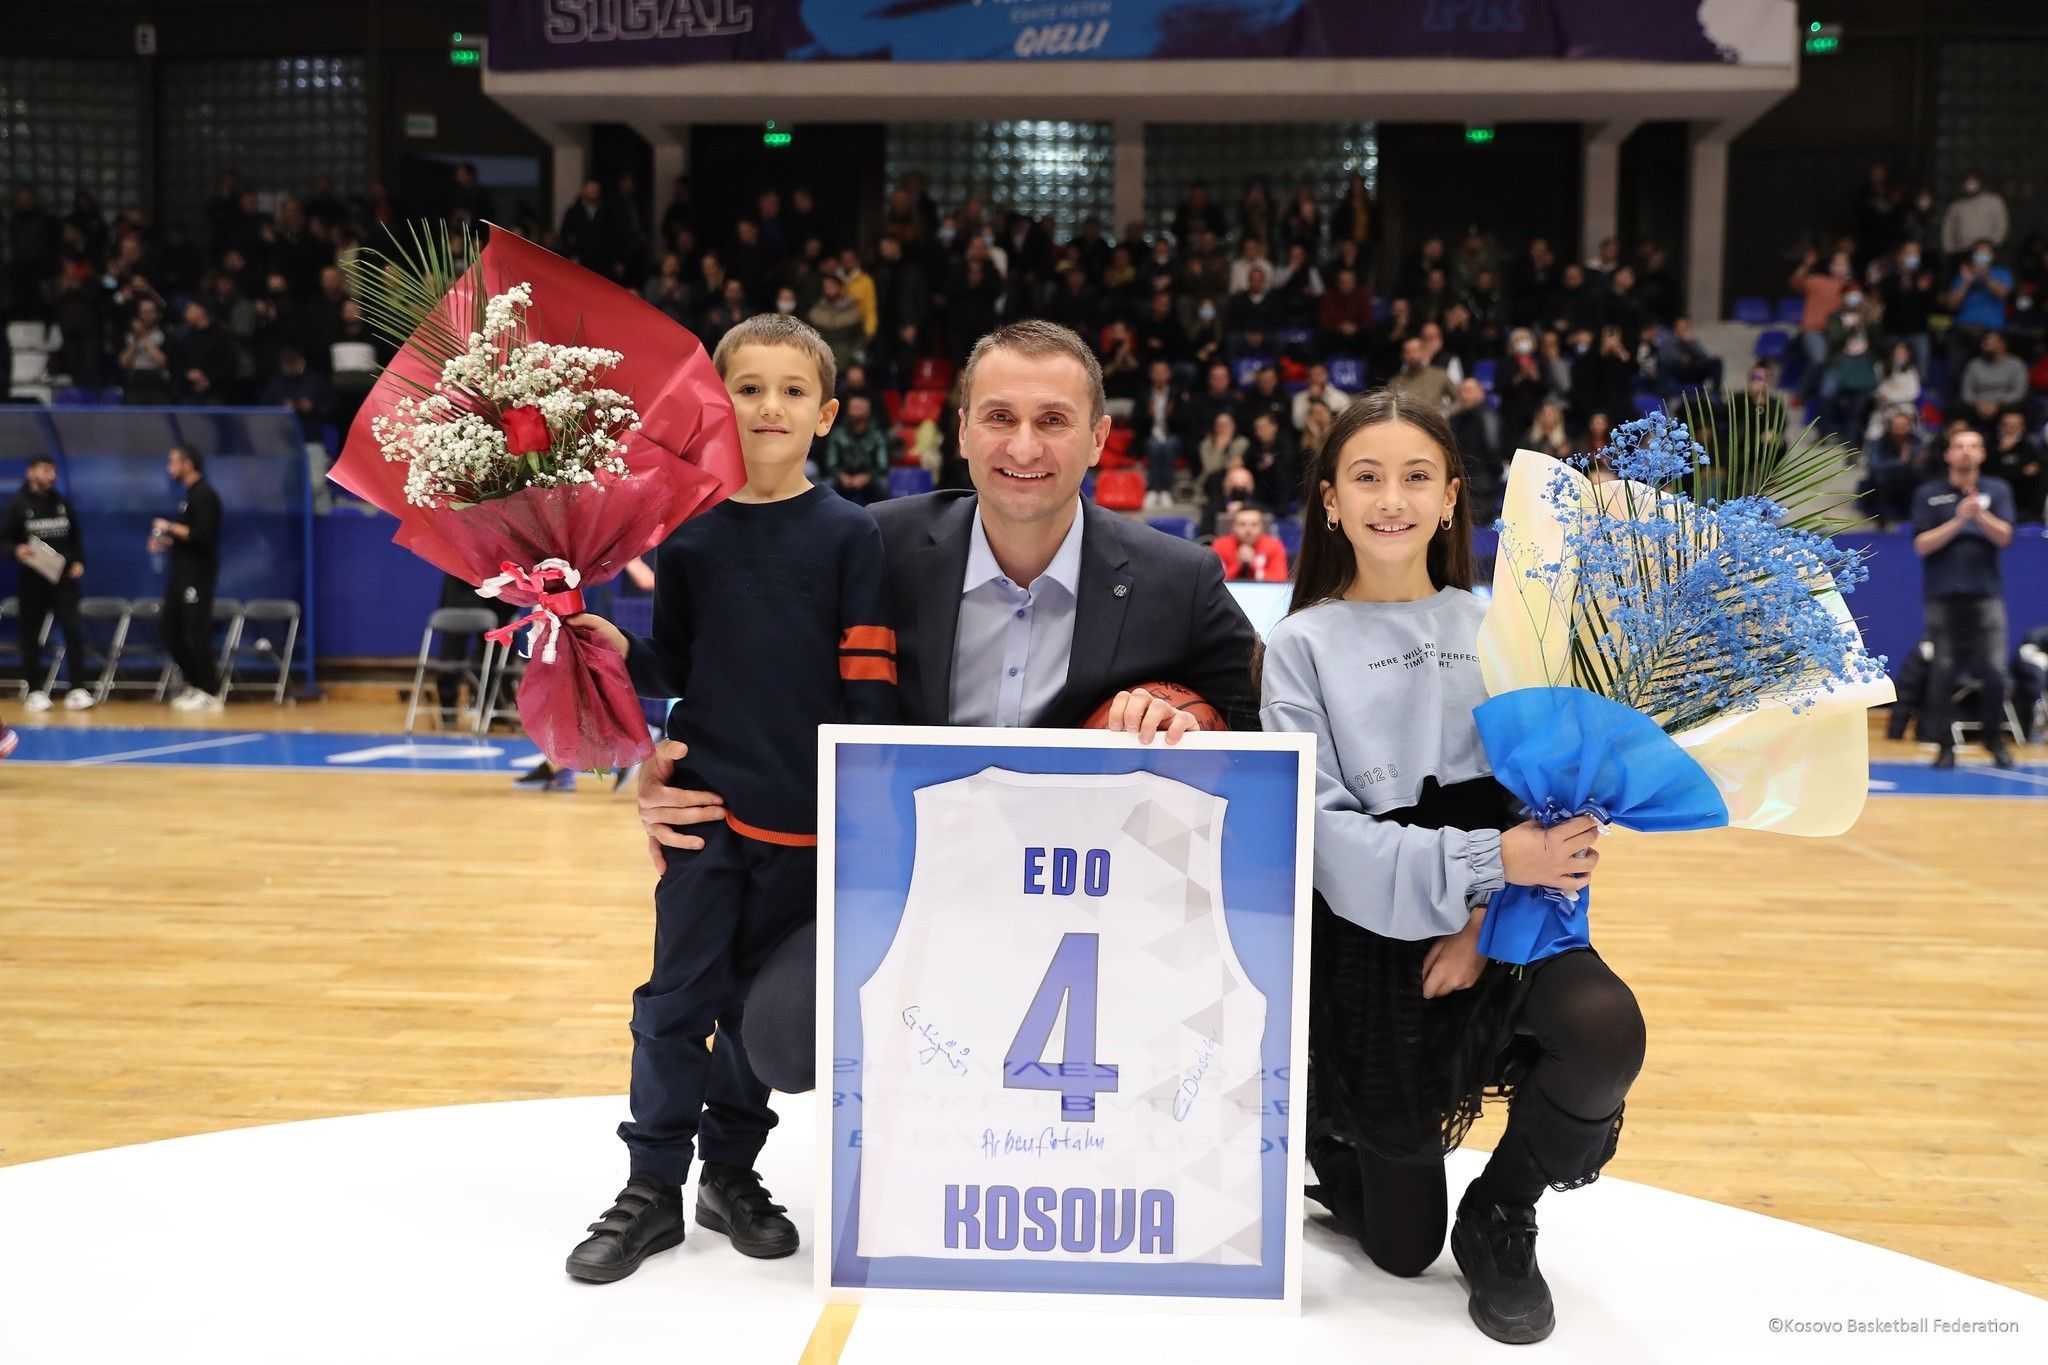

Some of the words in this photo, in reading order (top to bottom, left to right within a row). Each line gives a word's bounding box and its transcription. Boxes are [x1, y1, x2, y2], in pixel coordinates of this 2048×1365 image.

[544, 0, 753, 44] SIGAL
[1368, 656, 1399, 670] THERE
[1403, 647, 1423, 661] WILL
[1403, 656, 1425, 670] TIME
[1023, 847, 1111, 898] EDO
[1003, 932, 1119, 1123] 4
[944, 1184, 1175, 1255] KOSOVA
